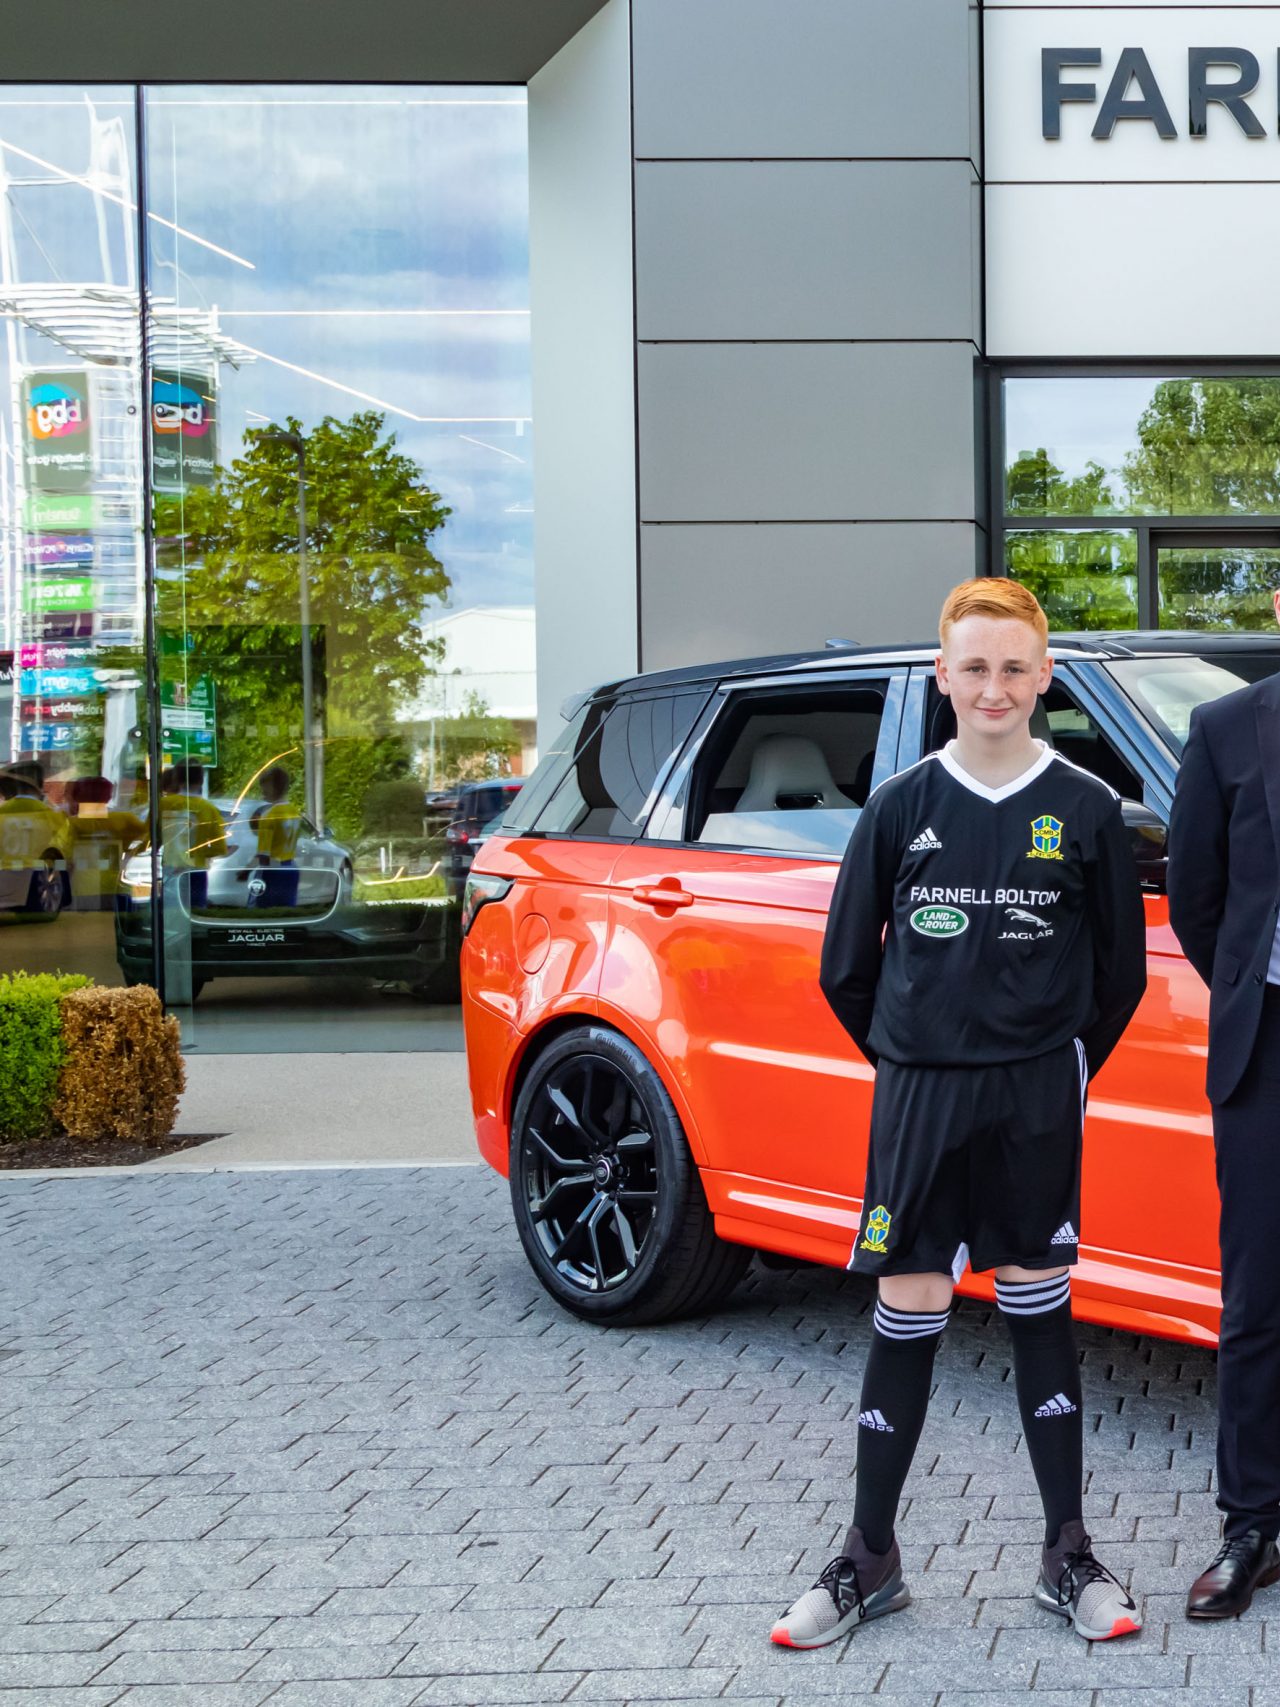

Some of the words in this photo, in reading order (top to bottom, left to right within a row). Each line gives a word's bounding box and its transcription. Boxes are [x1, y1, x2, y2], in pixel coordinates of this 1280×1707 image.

[909, 840, 942, 851] adidas
[911, 886, 992, 904] FARNELL
[995, 889, 1061, 906] BOLTON
[922, 911, 949, 921] LAND
[925, 920, 959, 930] ROVER
[227, 934, 285, 943] JAGUAR
[1051, 1235, 1079, 1245] adidas
[1034, 1404, 1077, 1417] adidas
